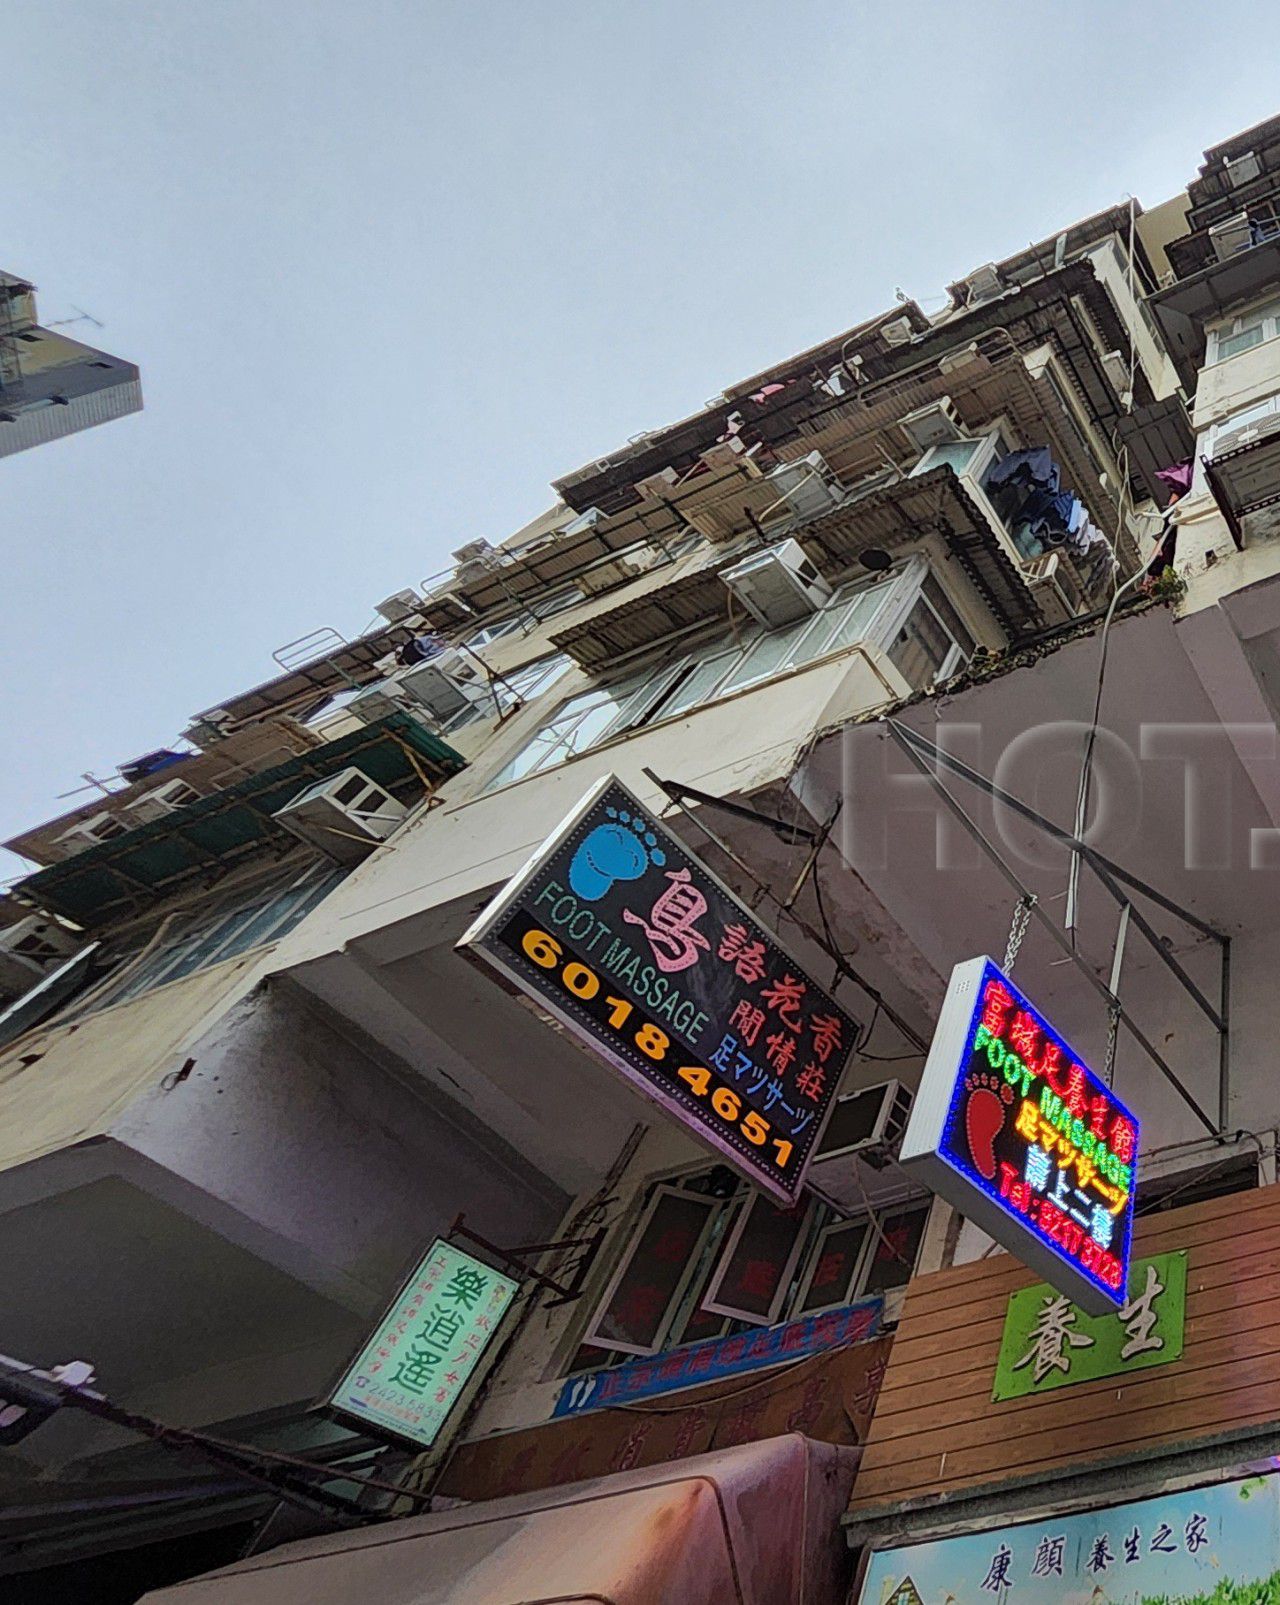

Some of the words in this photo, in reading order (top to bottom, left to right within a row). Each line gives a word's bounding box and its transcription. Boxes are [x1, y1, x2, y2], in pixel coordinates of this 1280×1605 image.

[533, 881, 611, 950] FOOT
[600, 937, 710, 1044] MASSAGE
[522, 929, 670, 1060] 6018
[677, 1066, 794, 1168] 4651
[974, 1023, 1037, 1097] FOOT
[1040, 1086, 1133, 1195] MASSAGE
[388, 1265, 489, 1396] 樂逍遙
[1012, 1265, 1165, 1385] 養生
